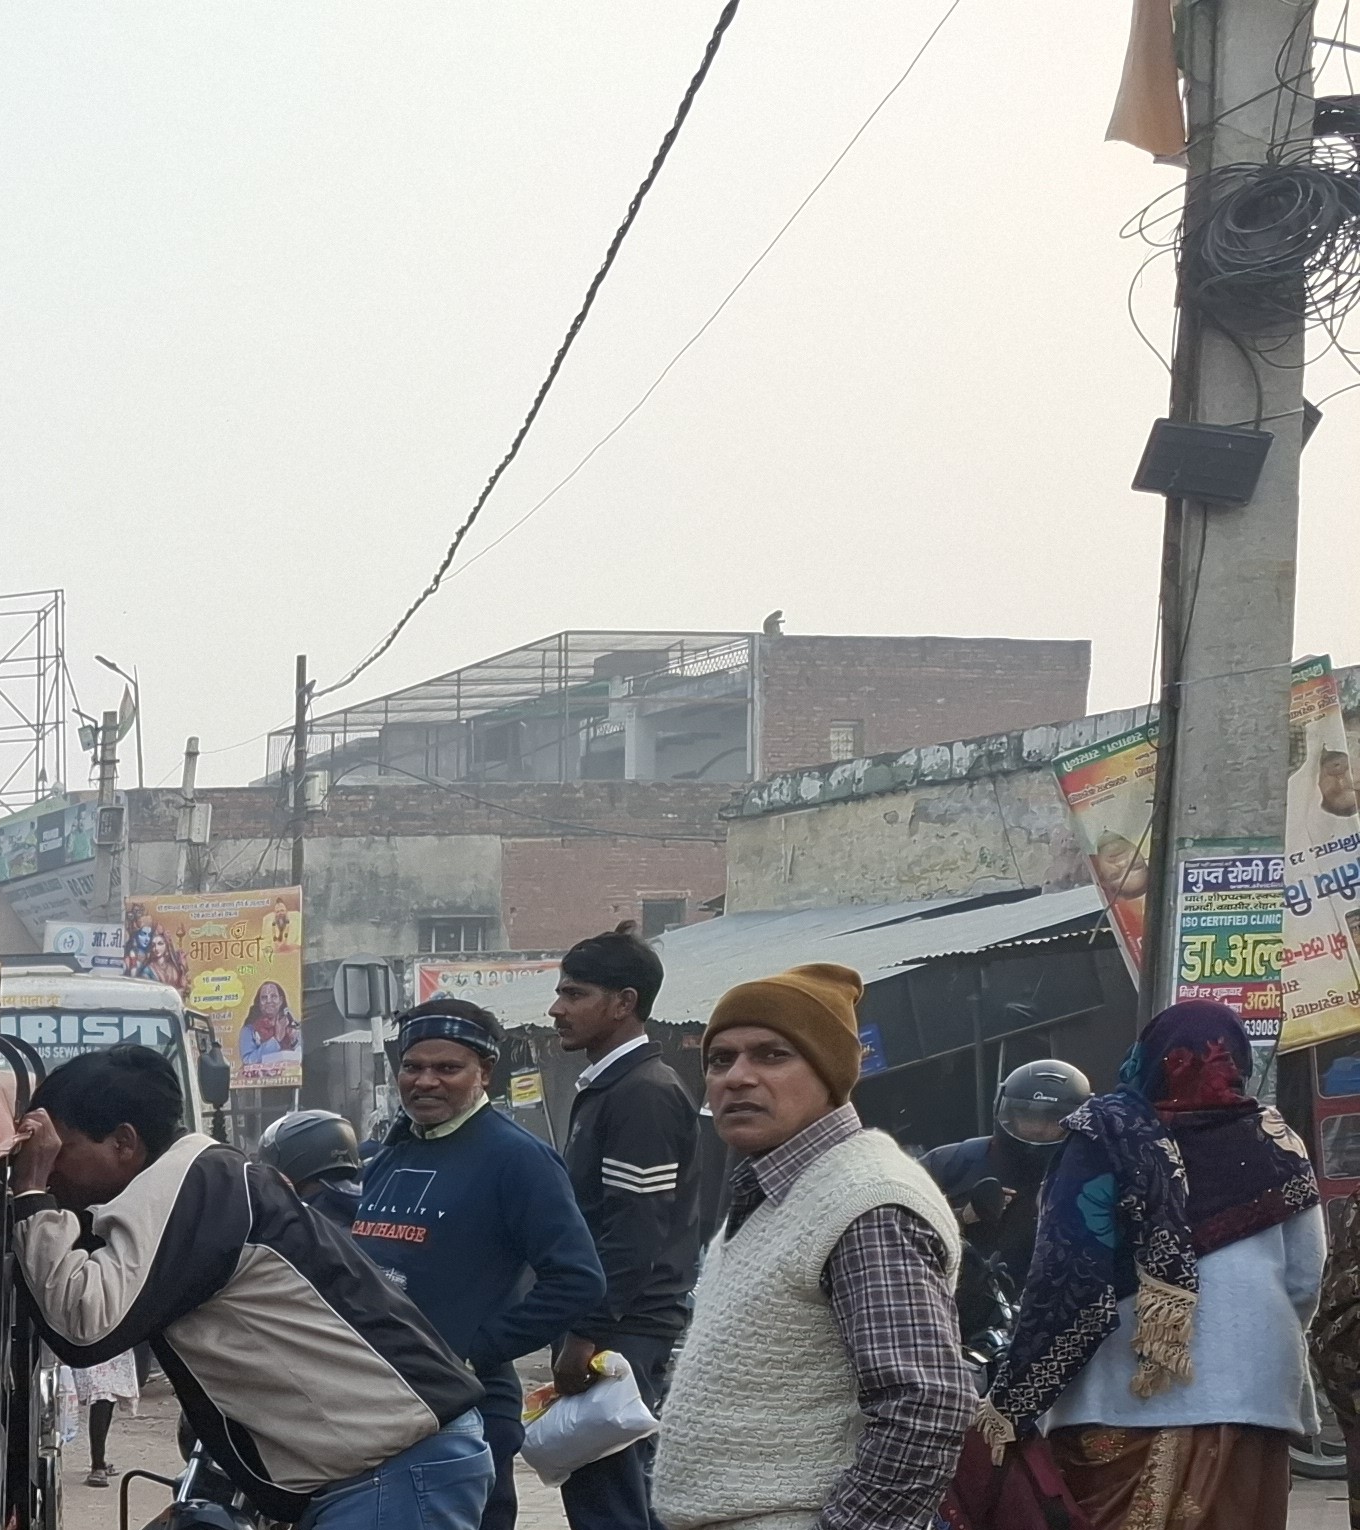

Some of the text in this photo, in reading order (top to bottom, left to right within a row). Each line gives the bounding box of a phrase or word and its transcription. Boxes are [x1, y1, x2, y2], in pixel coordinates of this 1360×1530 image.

[1289, 851, 1306, 866] 23
[1227, 861, 1265, 883] रोगी
[1182, 913, 1282, 928] ISO CERTIFIED CLINIC
